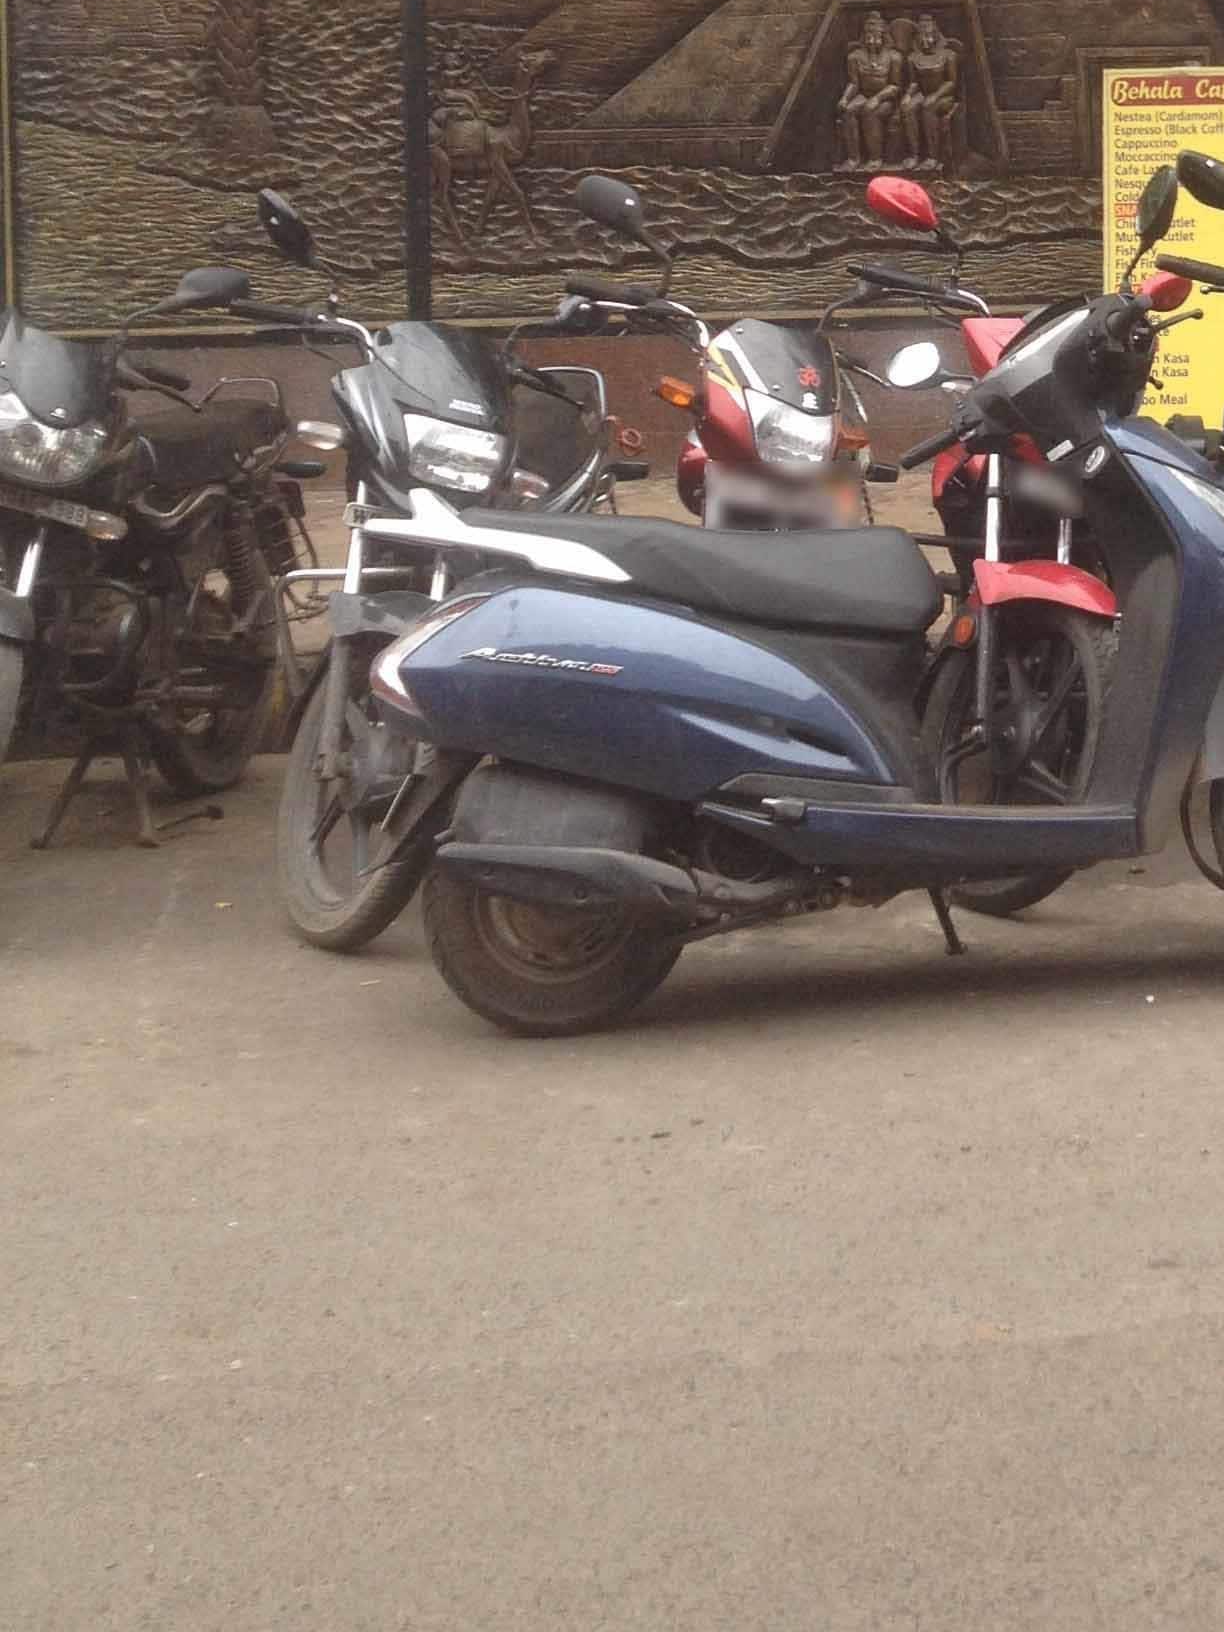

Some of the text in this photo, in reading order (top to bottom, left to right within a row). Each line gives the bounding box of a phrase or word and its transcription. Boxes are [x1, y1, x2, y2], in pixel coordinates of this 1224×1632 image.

[1112, 79, 1183, 103] Behala
[1114, 110, 1223, 123] Nestea (Cardamom)
[1114, 125, 1162, 137] Espresso
[1165, 123, 1197, 135] (Black
[1114, 138, 1178, 150] Cappuccino
[1115, 151, 1177, 162] Moccaccino
[1115, 164, 1140, 176] Cafe
[1169, 218, 1195, 229] utlet
[1163, 353, 1190, 364] Kasa
[1162, 367, 1189, 377] Kasa
[1160, 393, 1188, 405] Meal
